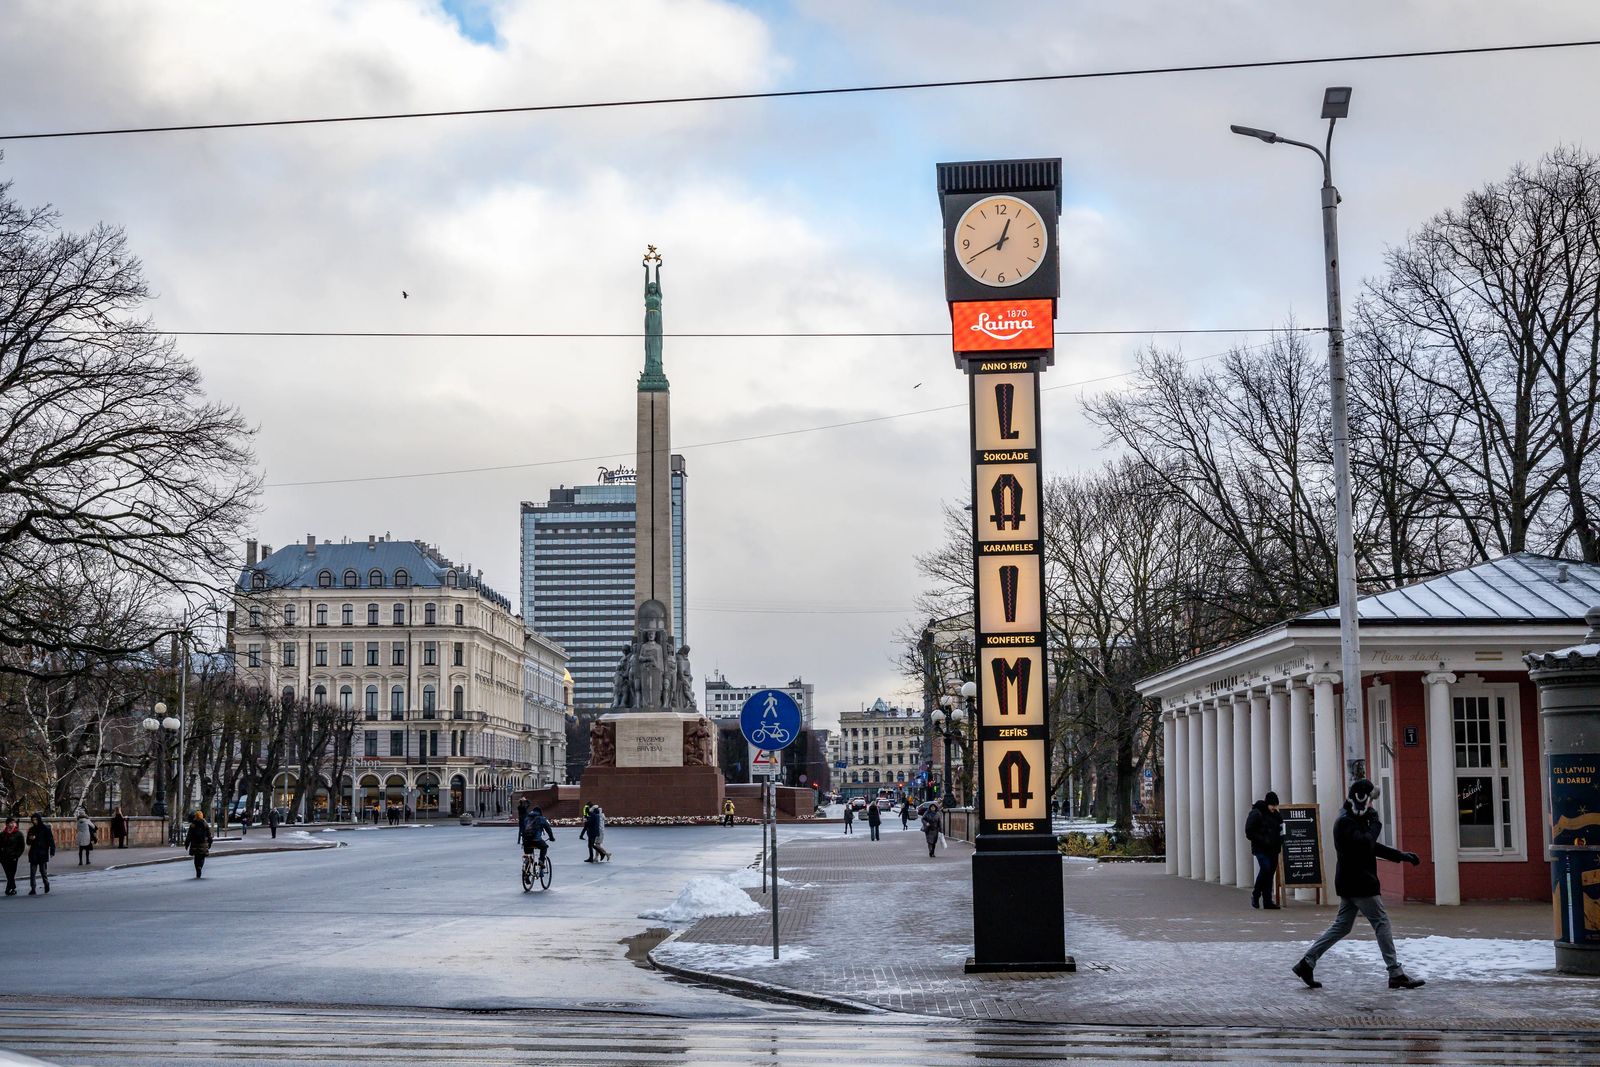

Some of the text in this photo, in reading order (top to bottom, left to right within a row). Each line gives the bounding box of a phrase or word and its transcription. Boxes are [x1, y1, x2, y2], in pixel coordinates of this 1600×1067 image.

[995, 204, 1007, 215] 12
[962, 239, 970, 249] 9
[1032, 238, 1040, 248] 3
[998, 272, 1005, 283] 6
[1007, 309, 1028, 318] 1870
[970, 312, 1035, 340] Laima
[981, 361, 1027, 371] ANNO 1870
[983, 451, 1029, 461] ŠOKOLĀDE
[597, 464, 637, 482] Radiss
[983, 543, 1034, 552] KARAMELES
[987, 635, 1035, 644] KONFEKTES
[999, 727, 1028, 737] ZEFĪRS
[997, 823, 1034, 831] LEDENES
